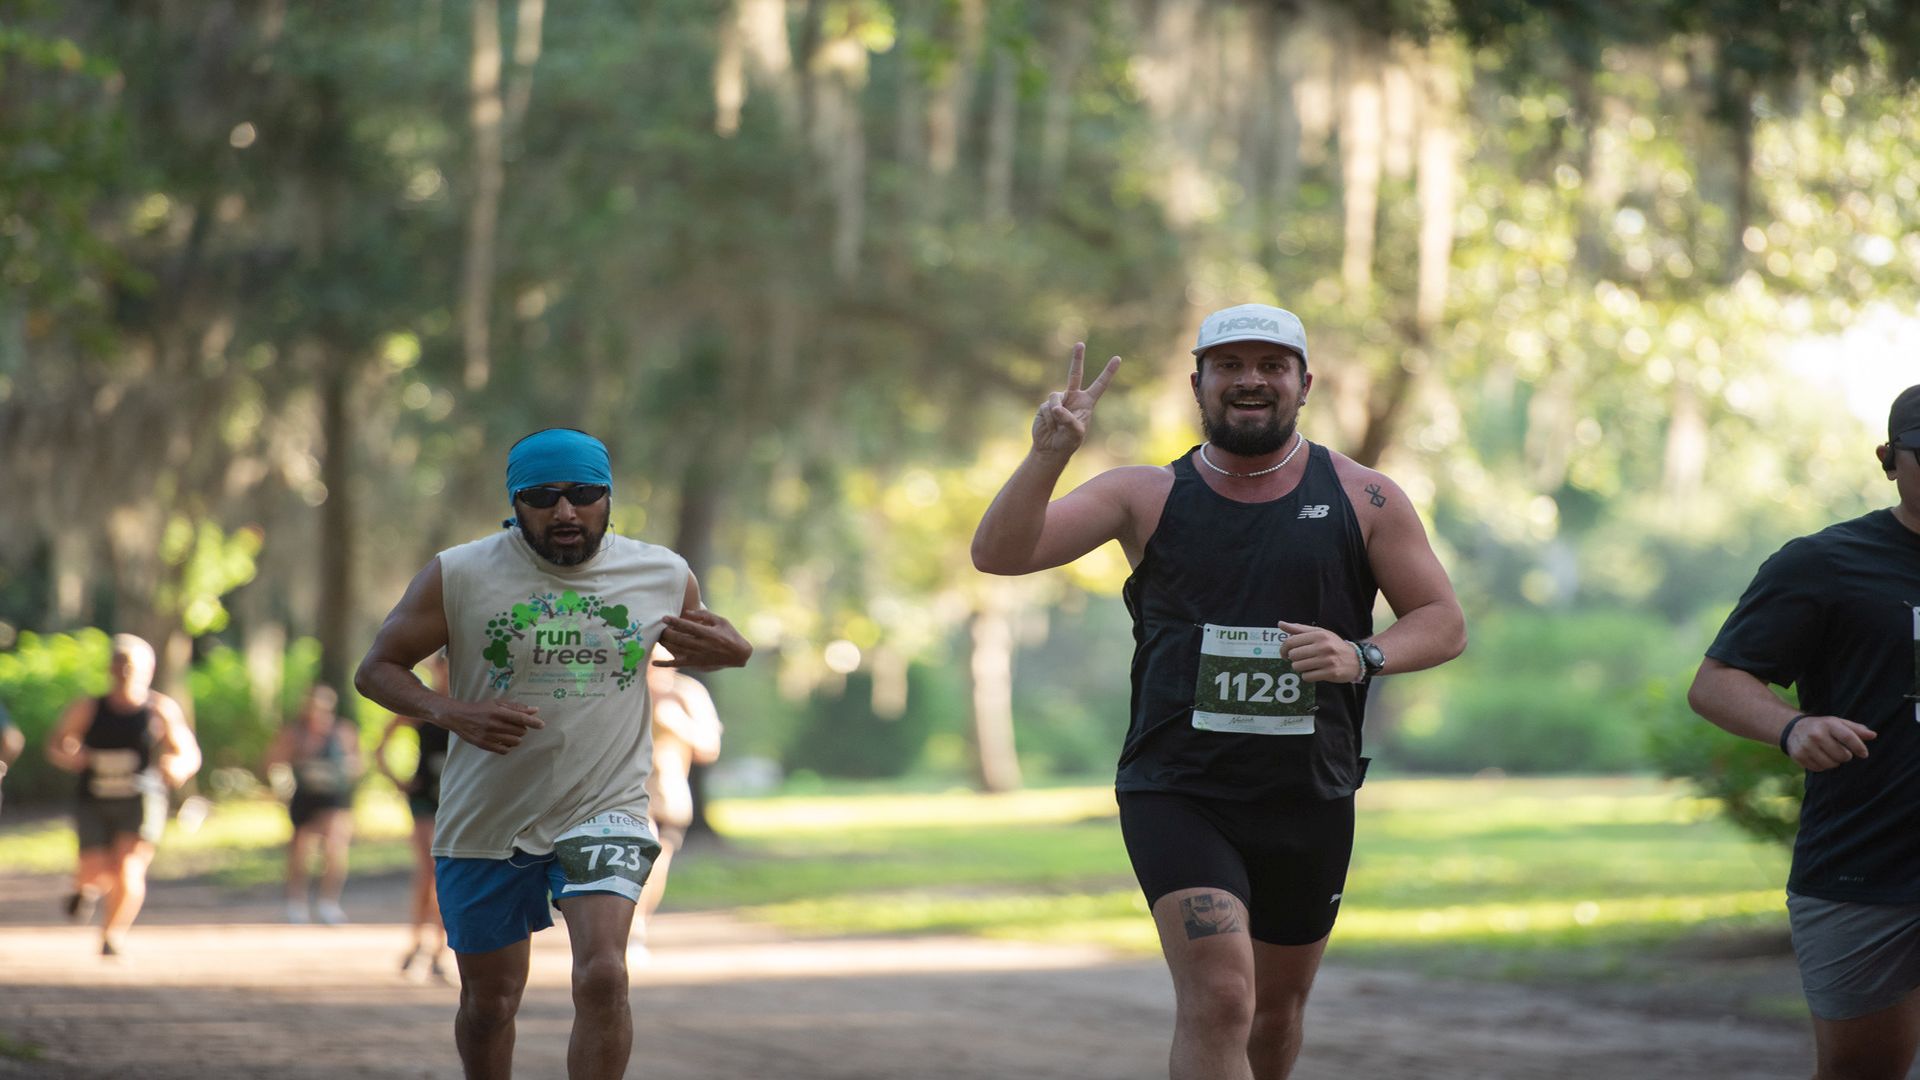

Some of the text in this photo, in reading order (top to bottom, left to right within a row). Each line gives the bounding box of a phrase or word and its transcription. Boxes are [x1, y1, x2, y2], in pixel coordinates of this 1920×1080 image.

[1216, 317, 1280, 335] HOKA
[536, 629, 581, 646] run
[1220, 629, 1248, 641] run
[1262, 630, 1289, 642] tre
[533, 645, 608, 665] trees
[1214, 671, 1301, 704] 1128
[580, 844, 641, 871] 723
